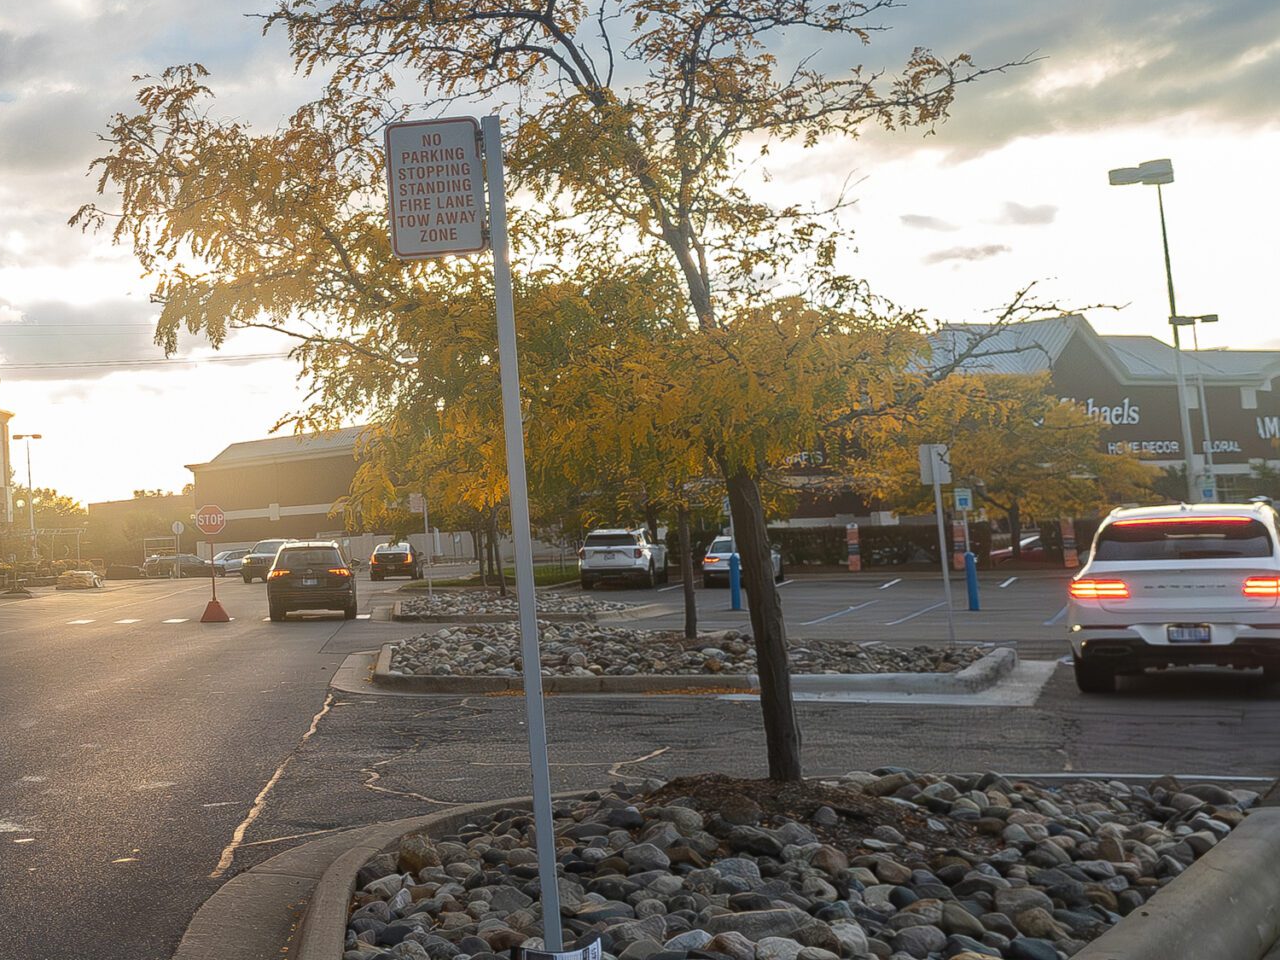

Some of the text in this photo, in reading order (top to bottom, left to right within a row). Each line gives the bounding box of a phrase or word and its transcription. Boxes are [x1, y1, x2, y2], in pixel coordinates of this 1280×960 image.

[422, 133, 442, 147] NO
[401, 147, 465, 164] PARKING
[398, 162, 471, 181] STOPPING
[399, 178, 472, 196] STANDING
[400, 194, 474, 212] FIRE LANE
[398, 210, 477, 228] TOW AWAY
[420, 227, 458, 243] ZONE
[1142, 441, 1180, 454] DECOR
[198, 514, 224, 526] STOP
